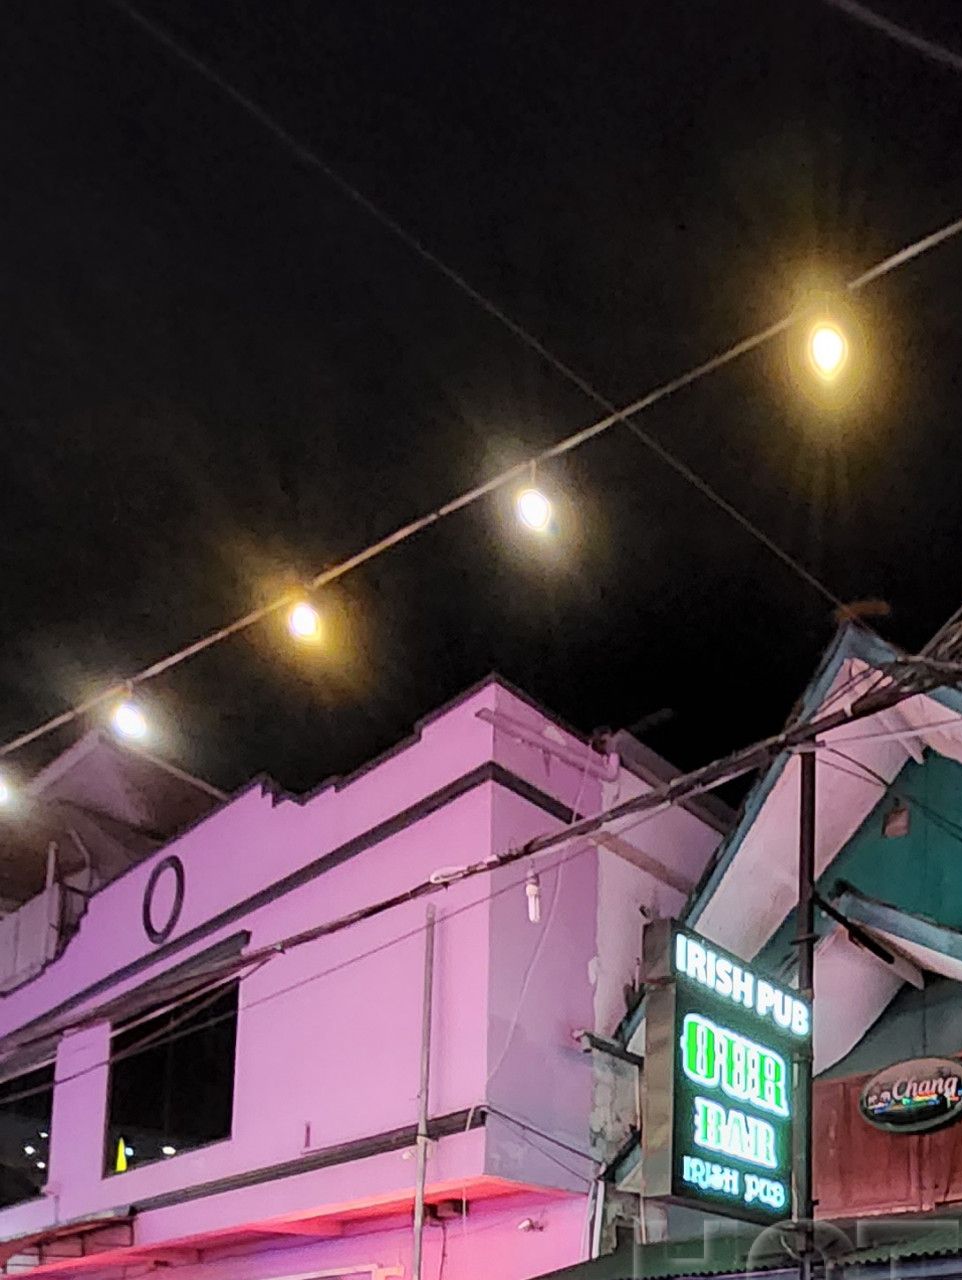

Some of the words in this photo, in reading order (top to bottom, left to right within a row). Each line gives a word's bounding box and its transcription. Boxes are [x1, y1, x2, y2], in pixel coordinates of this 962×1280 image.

[675, 933, 754, 1008] IRISH
[755, 979, 810, 1036] PUB
[681, 1012, 789, 1118] OUR
[892, 1076, 959, 1107] Chang
[694, 1096, 778, 1169] BAR
